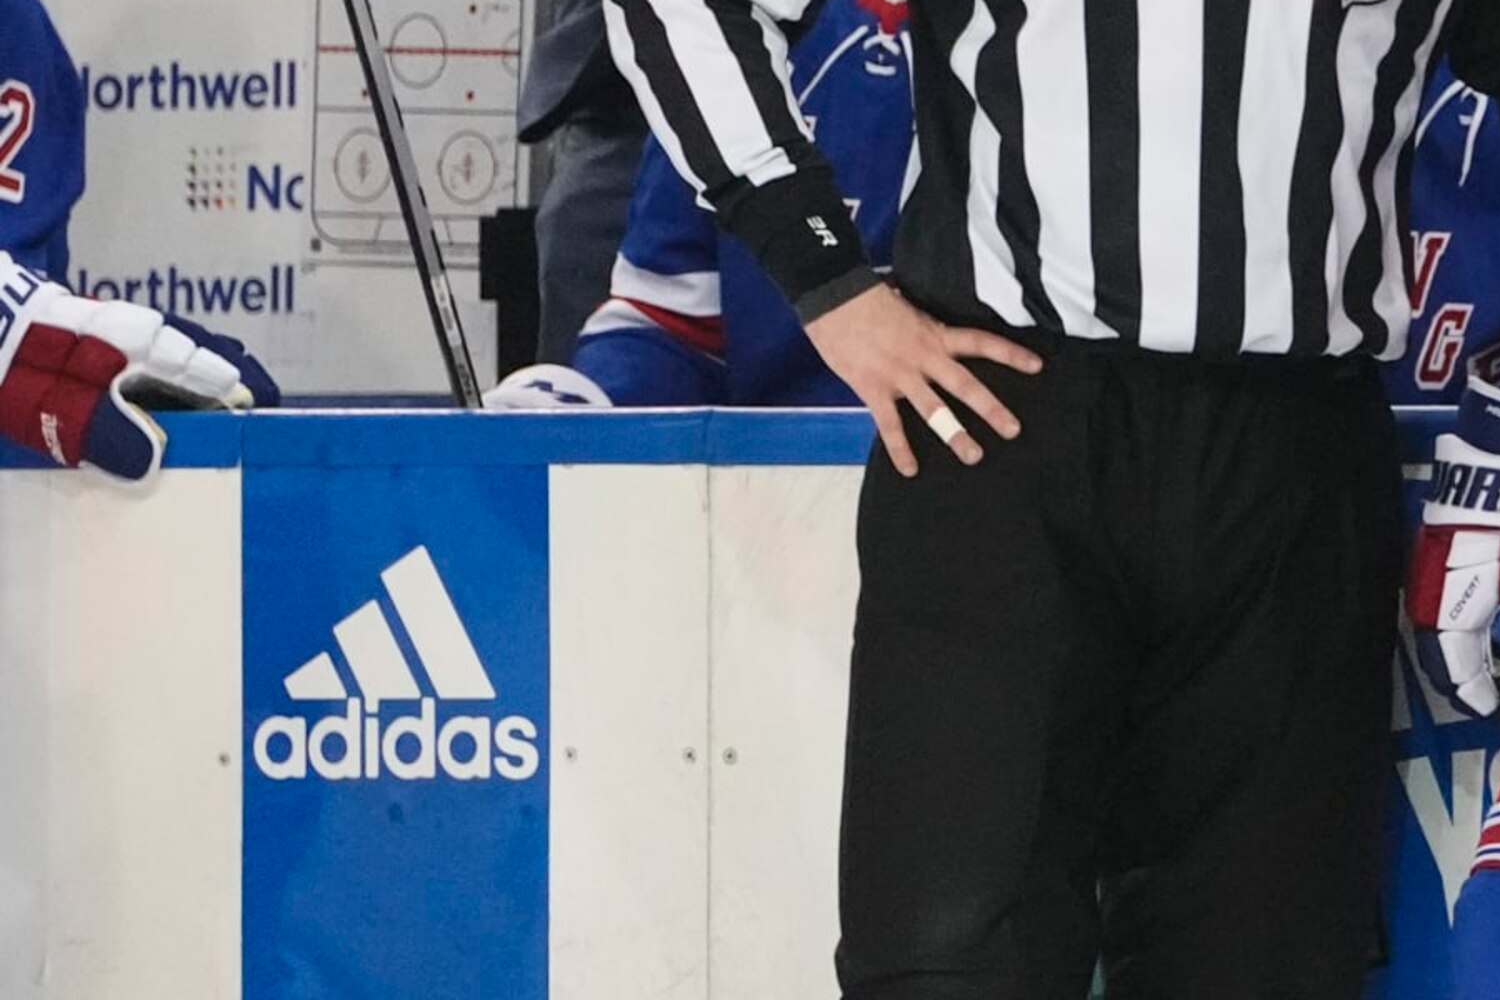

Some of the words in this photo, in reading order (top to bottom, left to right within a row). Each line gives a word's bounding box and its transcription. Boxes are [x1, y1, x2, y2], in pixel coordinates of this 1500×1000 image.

[81, 61, 297, 110] orthwell
[77, 264, 294, 314] orthwell
[1449, 573, 1482, 622] COVERT
[253, 697, 540, 781] adidas
